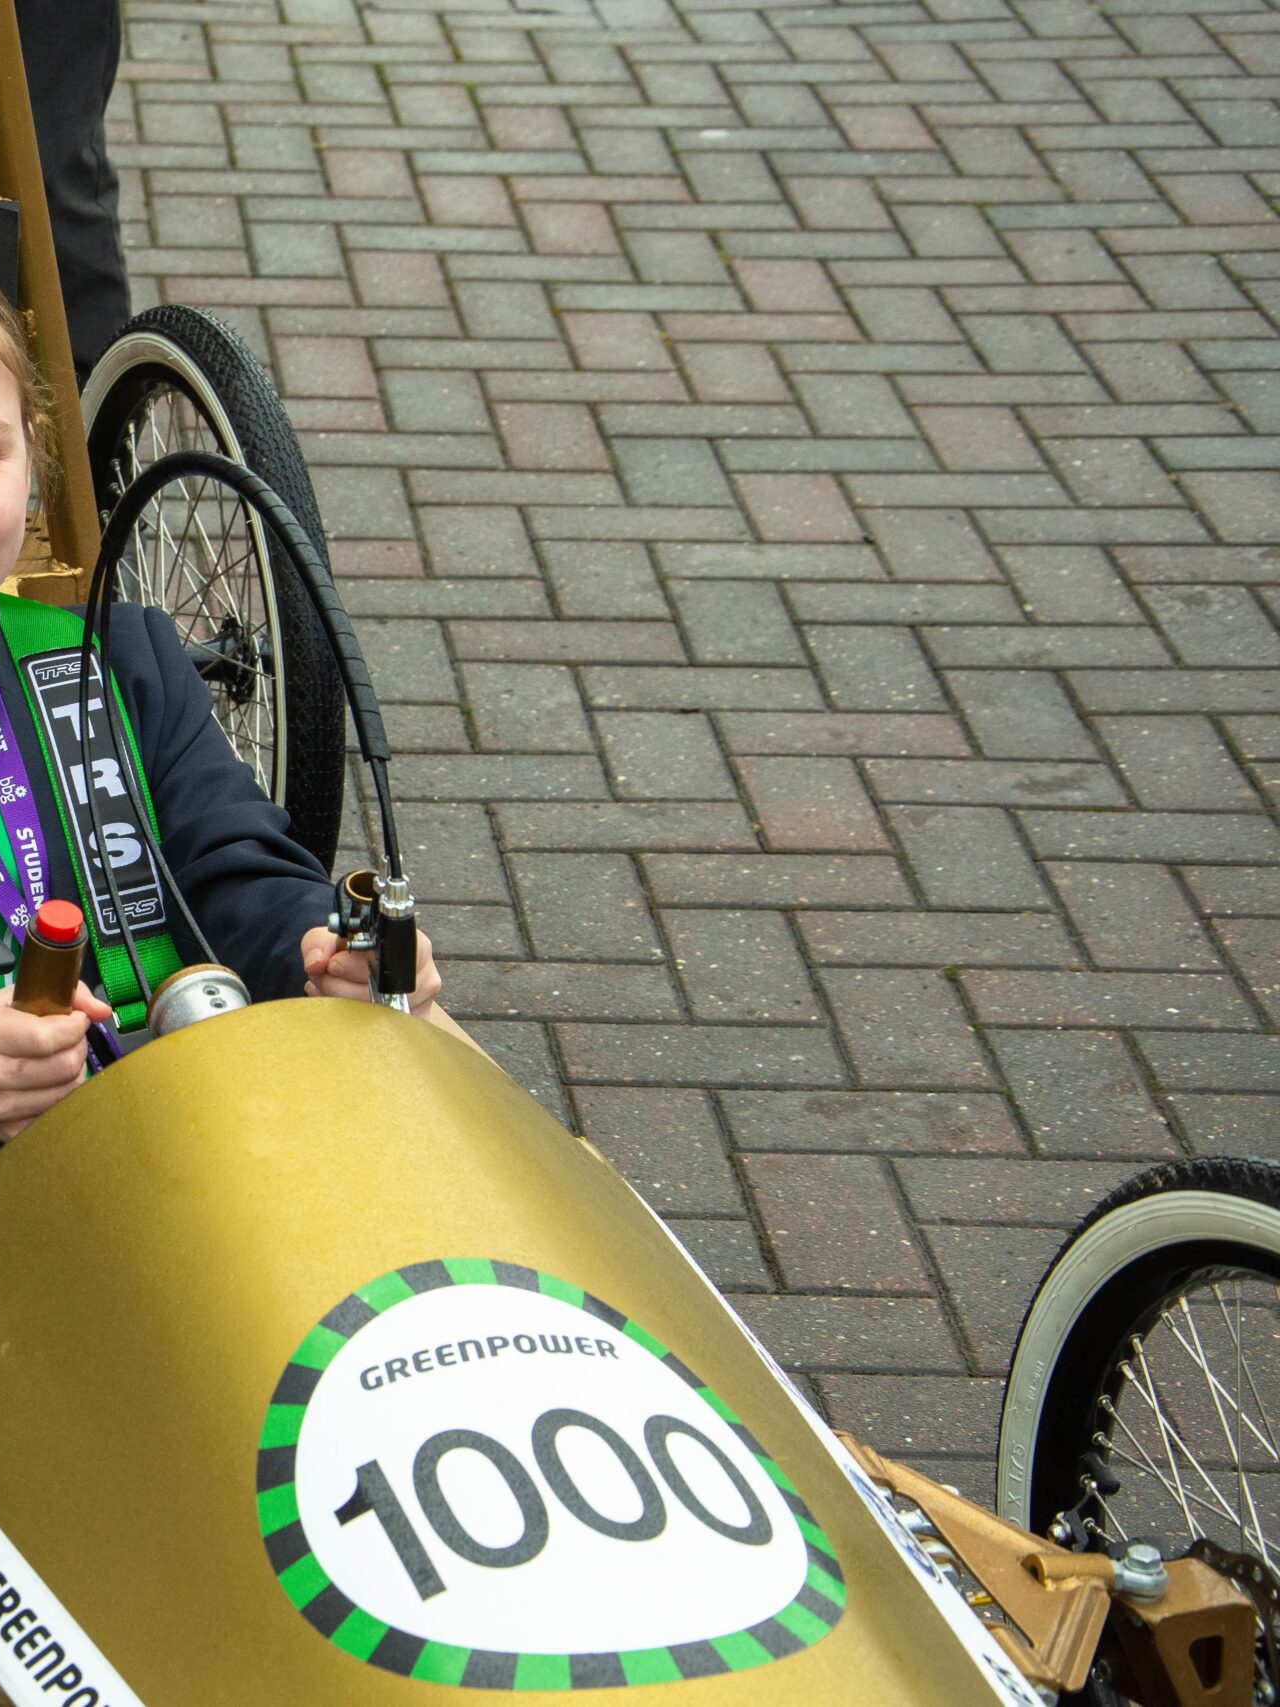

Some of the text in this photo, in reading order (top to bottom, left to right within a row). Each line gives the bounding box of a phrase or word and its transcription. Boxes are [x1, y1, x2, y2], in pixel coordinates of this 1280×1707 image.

[35, 662, 90, 681] TRS
[0, 775, 16, 804] bbg
[51, 697, 142, 869] TRS
[16, 827, 44, 910] STUDEN
[103, 898, 158, 923] TRS
[360, 1333, 620, 1391] GREENPOWER
[333, 1408, 774, 1602] 1000
